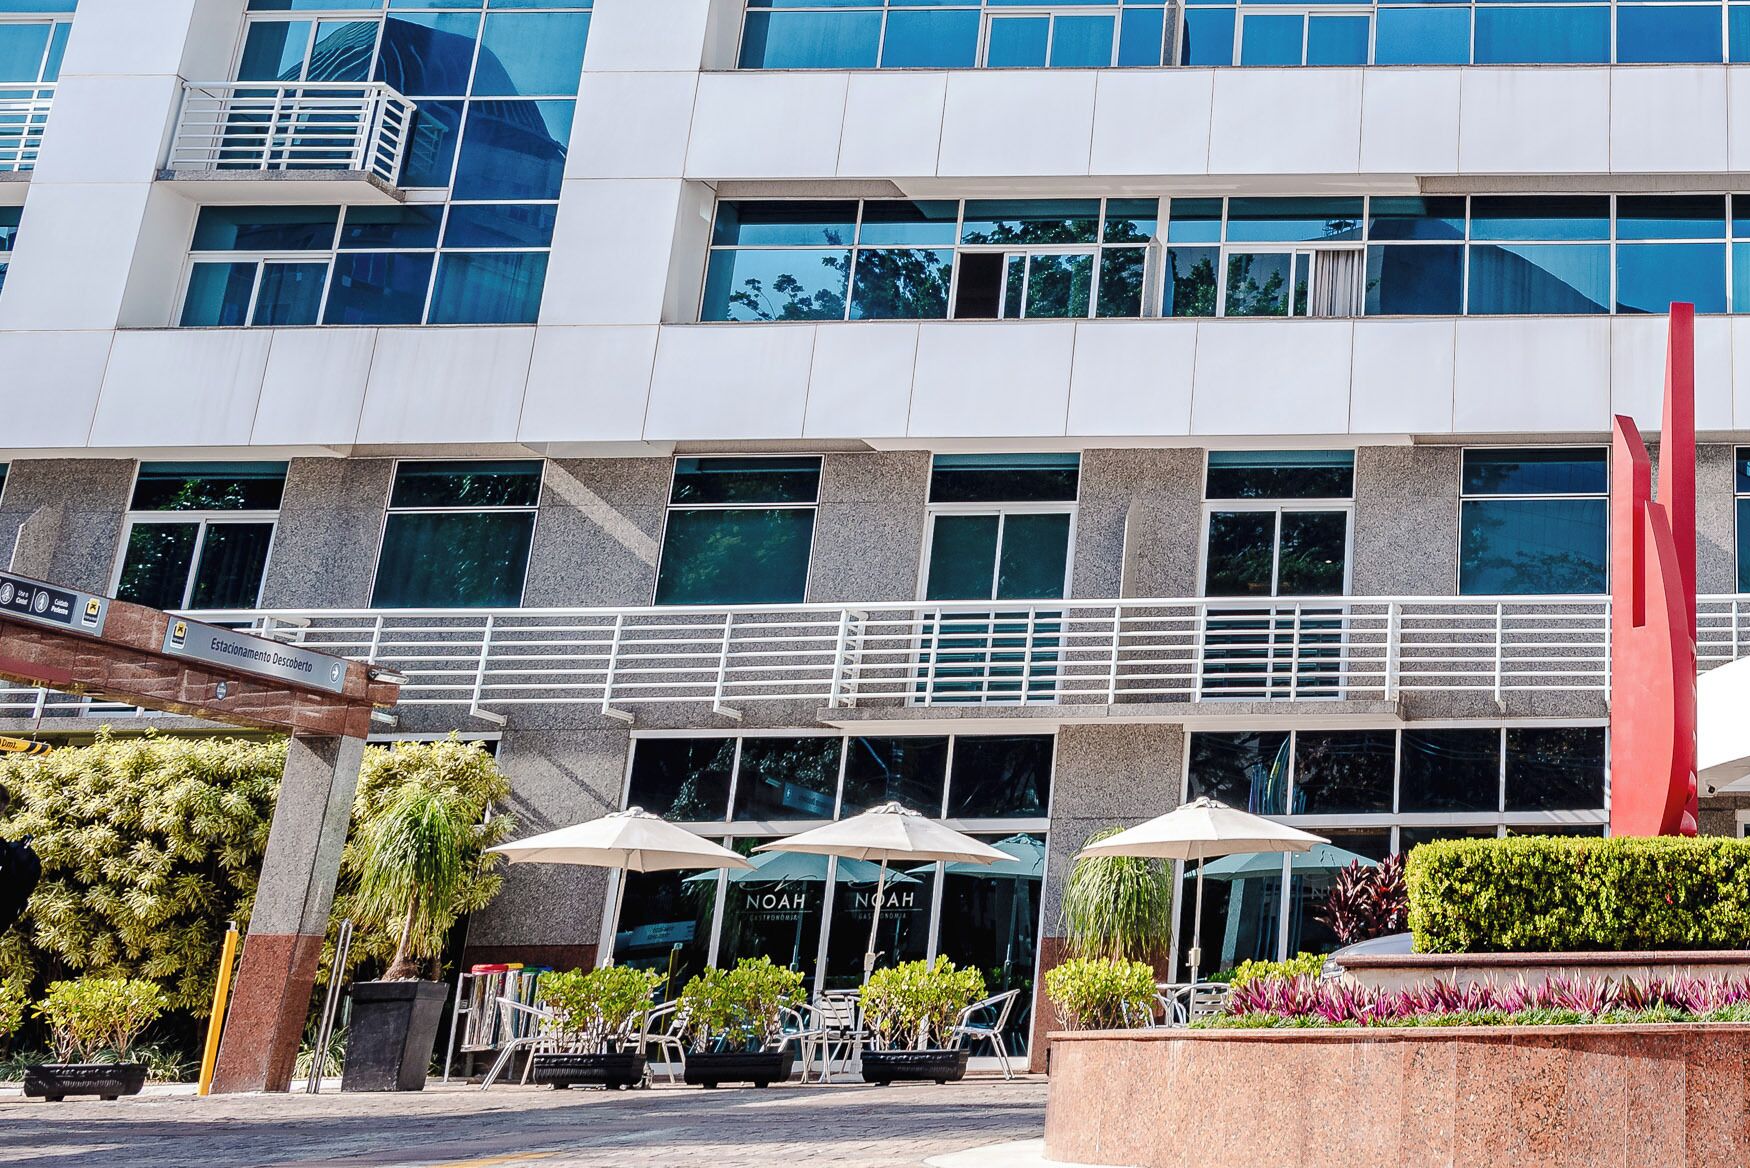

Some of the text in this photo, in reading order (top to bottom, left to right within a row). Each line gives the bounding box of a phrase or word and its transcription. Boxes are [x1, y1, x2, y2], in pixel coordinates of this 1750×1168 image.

[210, 637, 313, 673] Estacionamento Descoberto
[746, 894, 806, 909] NOAH
[855, 892, 914, 908] NOAH
